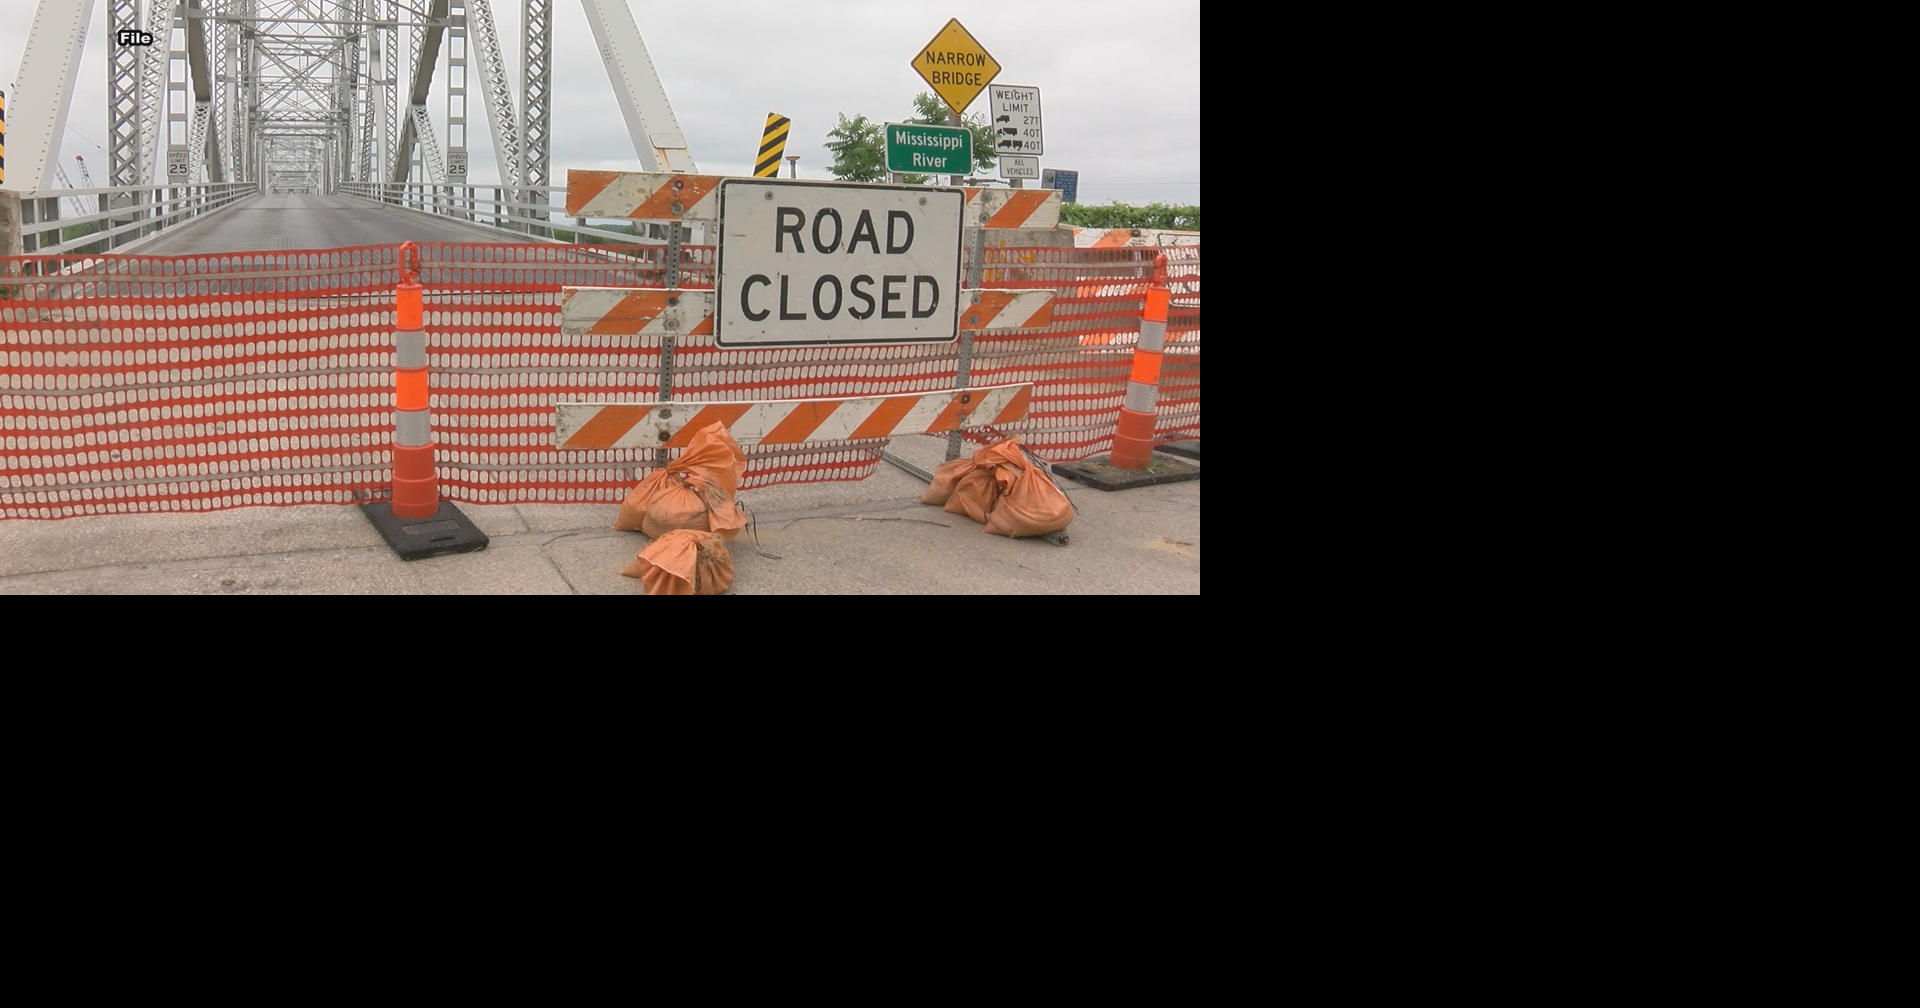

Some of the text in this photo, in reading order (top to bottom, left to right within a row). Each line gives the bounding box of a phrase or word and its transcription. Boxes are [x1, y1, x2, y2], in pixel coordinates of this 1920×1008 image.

[926, 51, 986, 67] NARROW
[932, 71, 982, 86] BRIDGE
[995, 90, 1034, 101] WEIGHT
[1002, 103, 1029, 113] LIMIT
[1023, 116, 1039, 125] 27T
[1023, 129, 1040, 138] 40T
[895, 130, 963, 151] Mississippi
[1023, 141, 1041, 150] 40T
[912, 152, 947, 168] River
[169, 164, 188, 174] 25
[449, 164, 466, 174] 25
[1006, 168, 1034, 176] VEHICLES
[775, 206, 915, 255] ROAD
[740, 273, 940, 322] CLOSED
